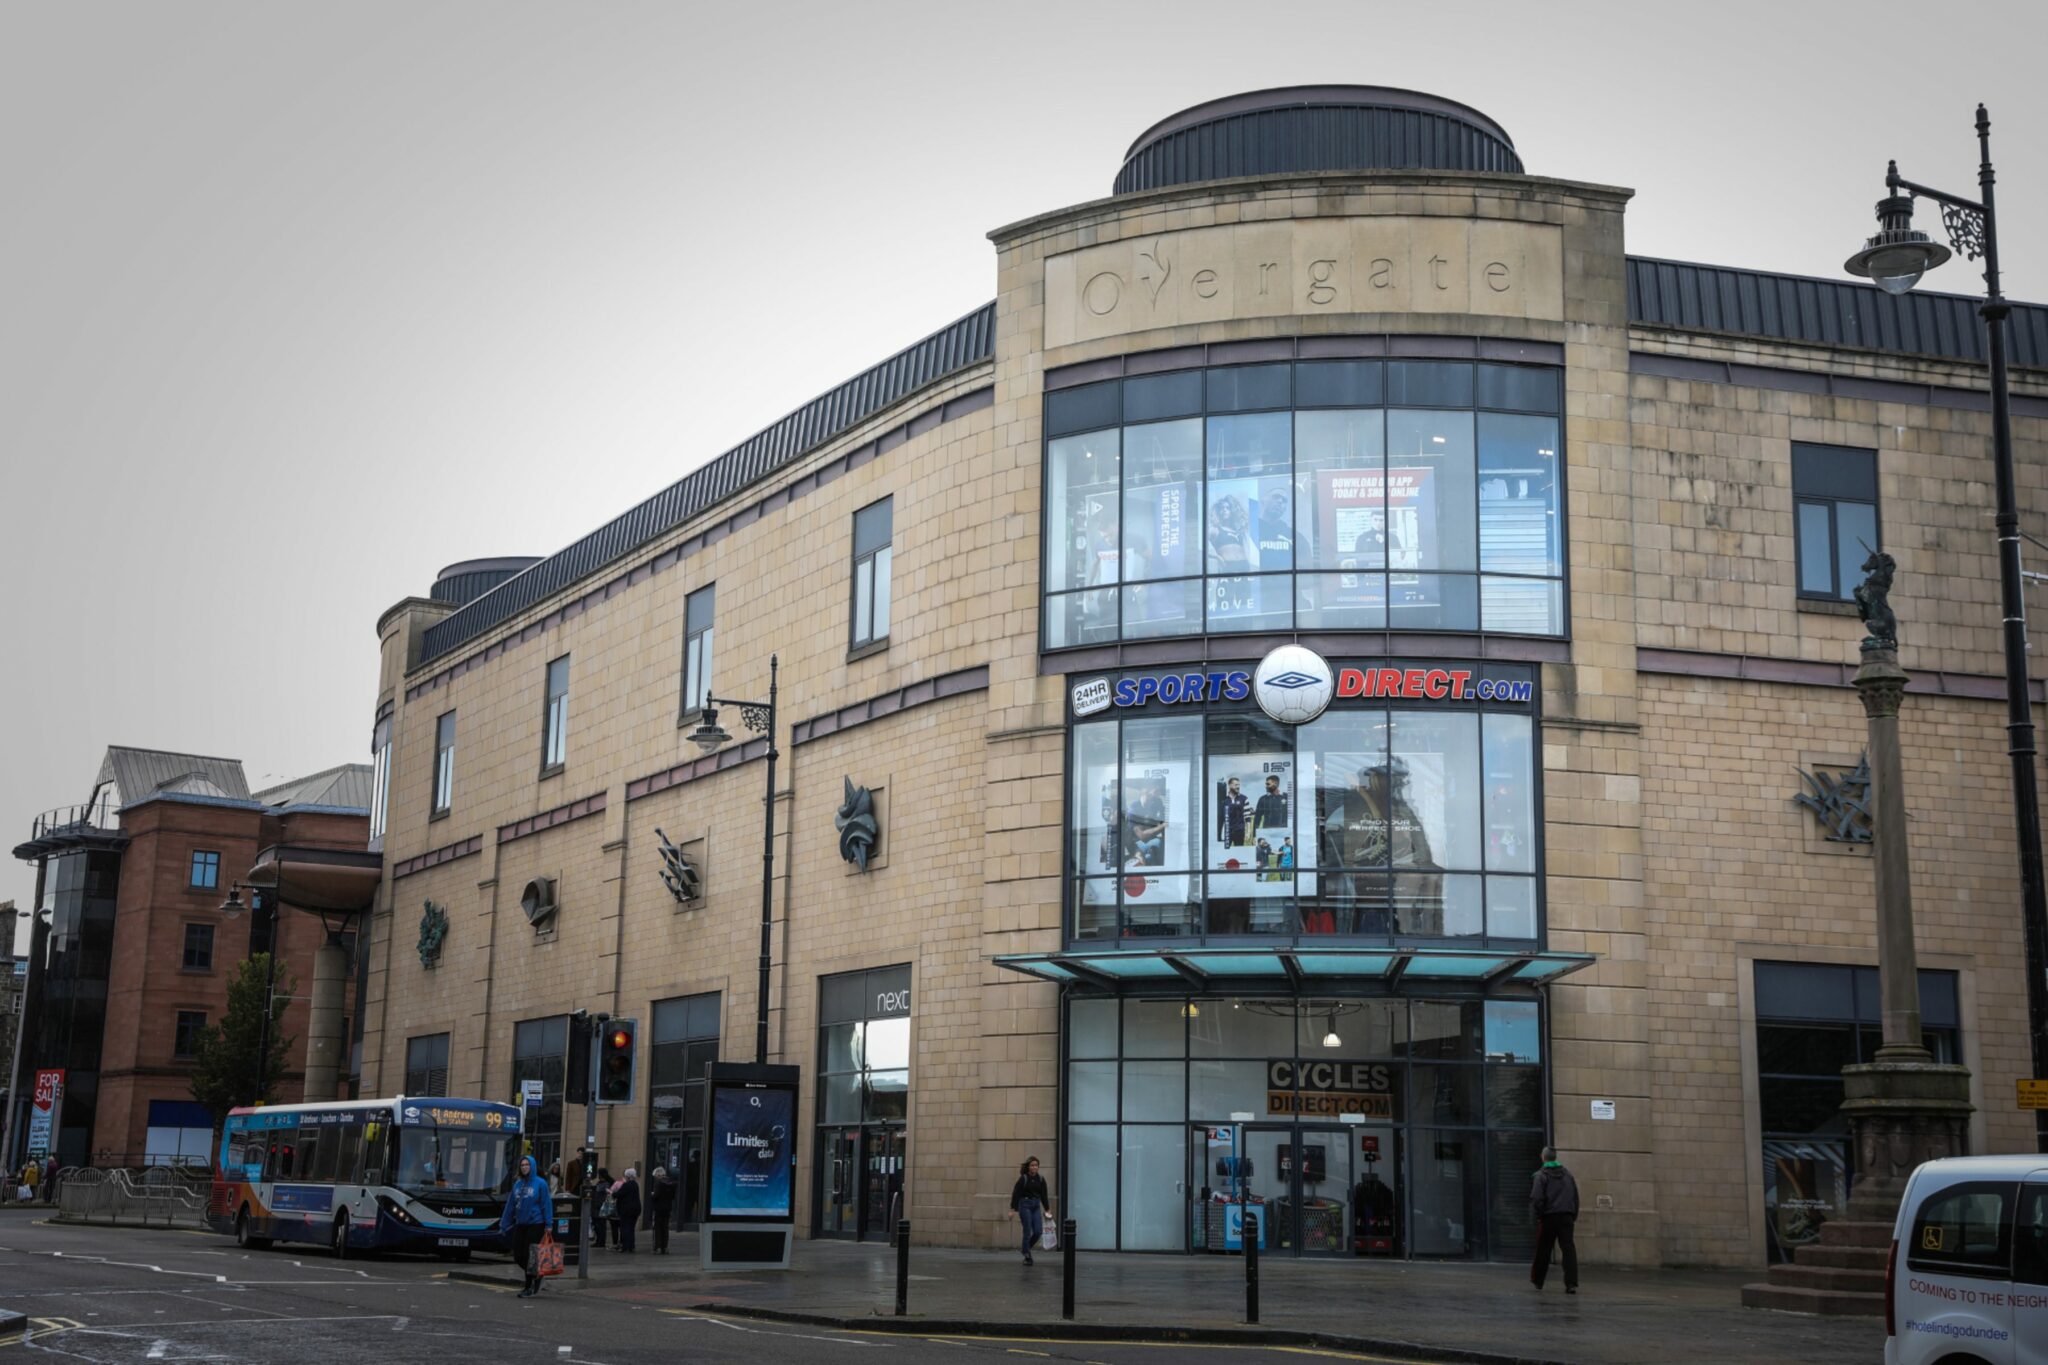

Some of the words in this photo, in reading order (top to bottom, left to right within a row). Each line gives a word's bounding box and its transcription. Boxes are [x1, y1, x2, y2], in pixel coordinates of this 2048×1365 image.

[1332, 477, 1377, 488] DOWNLOAD
[1397, 476, 1413, 487] APP
[1332, 488, 1358, 499] TODAY
[1367, 487, 1387, 498] SHO
[1390, 486, 1420, 498] ONLINE
[1171, 489, 1180, 522] SPORT
[1161, 489, 1170, 557] UNEXPECTED
[1171, 526, 1180, 546] THE
[1076, 682, 1107, 702] 24HR
[1113, 671, 1250, 707] SPORTS
[1076, 694, 1110, 710] DELIVERY
[877, 989, 910, 1012] next
[39, 1073, 60, 1087] FOR
[1270, 1061, 1390, 1091] CYCLES
[1269, 1095, 1391, 1114] DIRECT.COM
[485, 1112, 502, 1129] 99
[726, 1132, 769, 1148] Limitless
[758, 1148, 775, 1159] data
[1909, 1278, 1957, 1301] COMING
[1959, 1289, 1977, 1304] TO
[1980, 1291, 2004, 1307] THE
[2007, 1294, 2048, 1309] NEIGH
[1905, 1320, 2009, 1341] #hotelindigodundee
